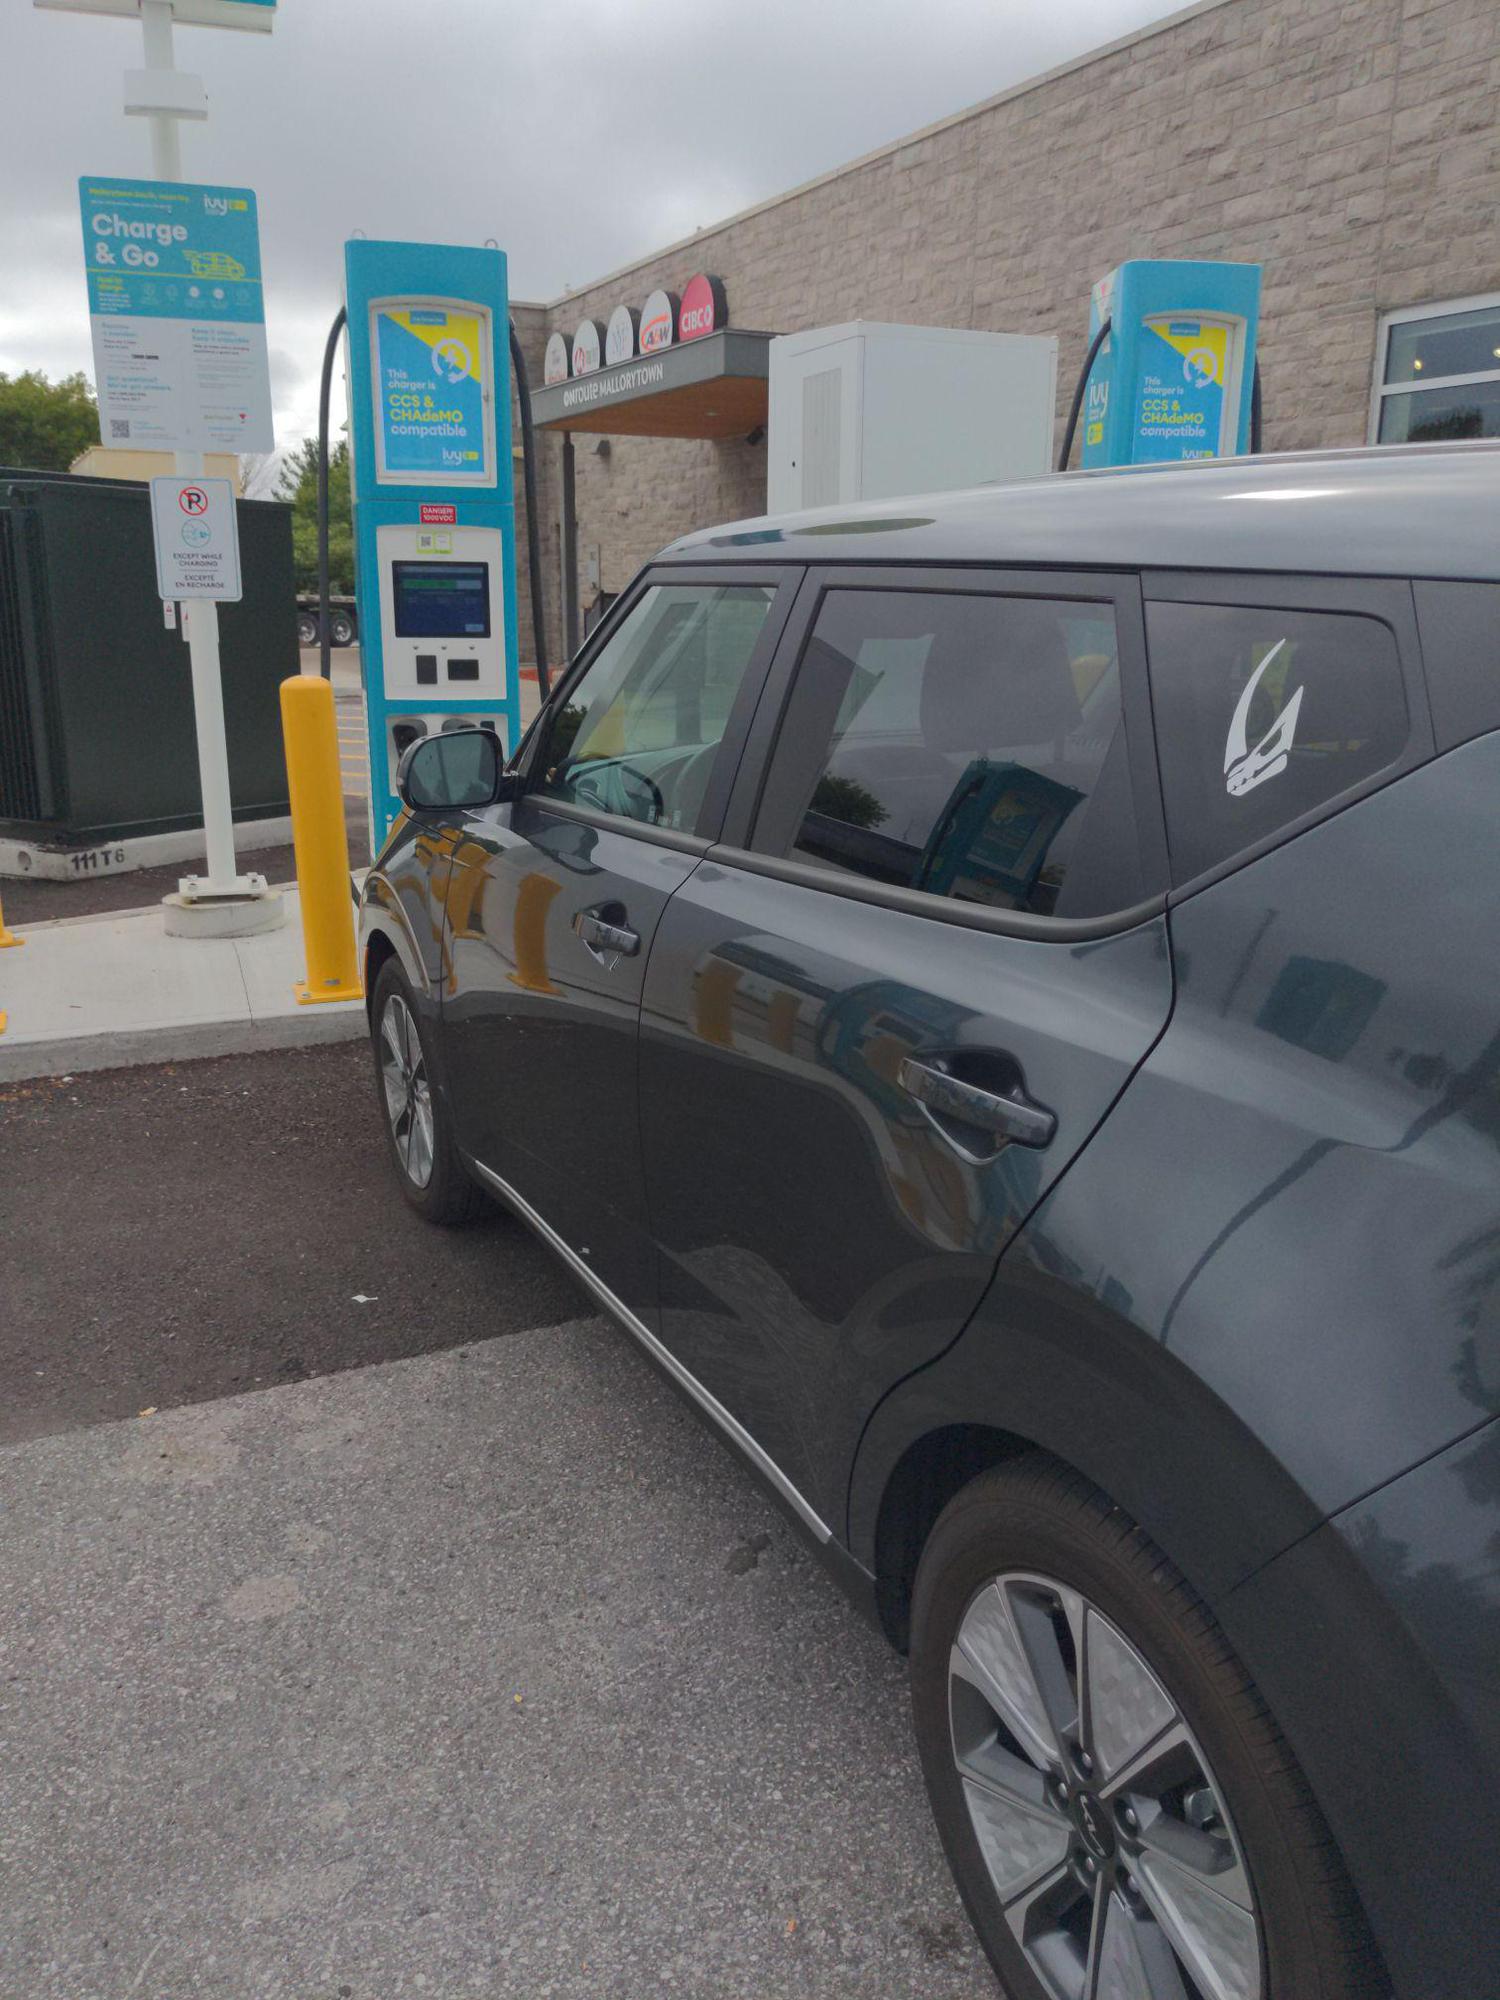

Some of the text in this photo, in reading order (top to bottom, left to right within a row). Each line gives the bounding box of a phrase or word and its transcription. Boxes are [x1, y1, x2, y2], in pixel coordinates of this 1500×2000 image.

[204, 194, 229, 216] ivy
[92, 213, 188, 246] Charge
[95, 242, 159, 266] & Go
[682, 307, 704, 333] CIBC
[388, 370, 407, 379] This
[600, 364, 663, 397] MALLORYTOWN
[1143, 376, 1161, 386] This
[388, 379, 436, 391] charger is
[1143, 385, 1184, 396] charger is
[389, 395, 434, 408] CCS &
[1142, 399, 1181, 411] CCS &
[390, 409, 463, 422] CHAdeMO
[391, 424, 466, 437] compatible
[1140, 425, 1206, 438] compatible
[173, 552, 198, 560] EXCEPT
[187, 581, 225, 589] RECHARGE
